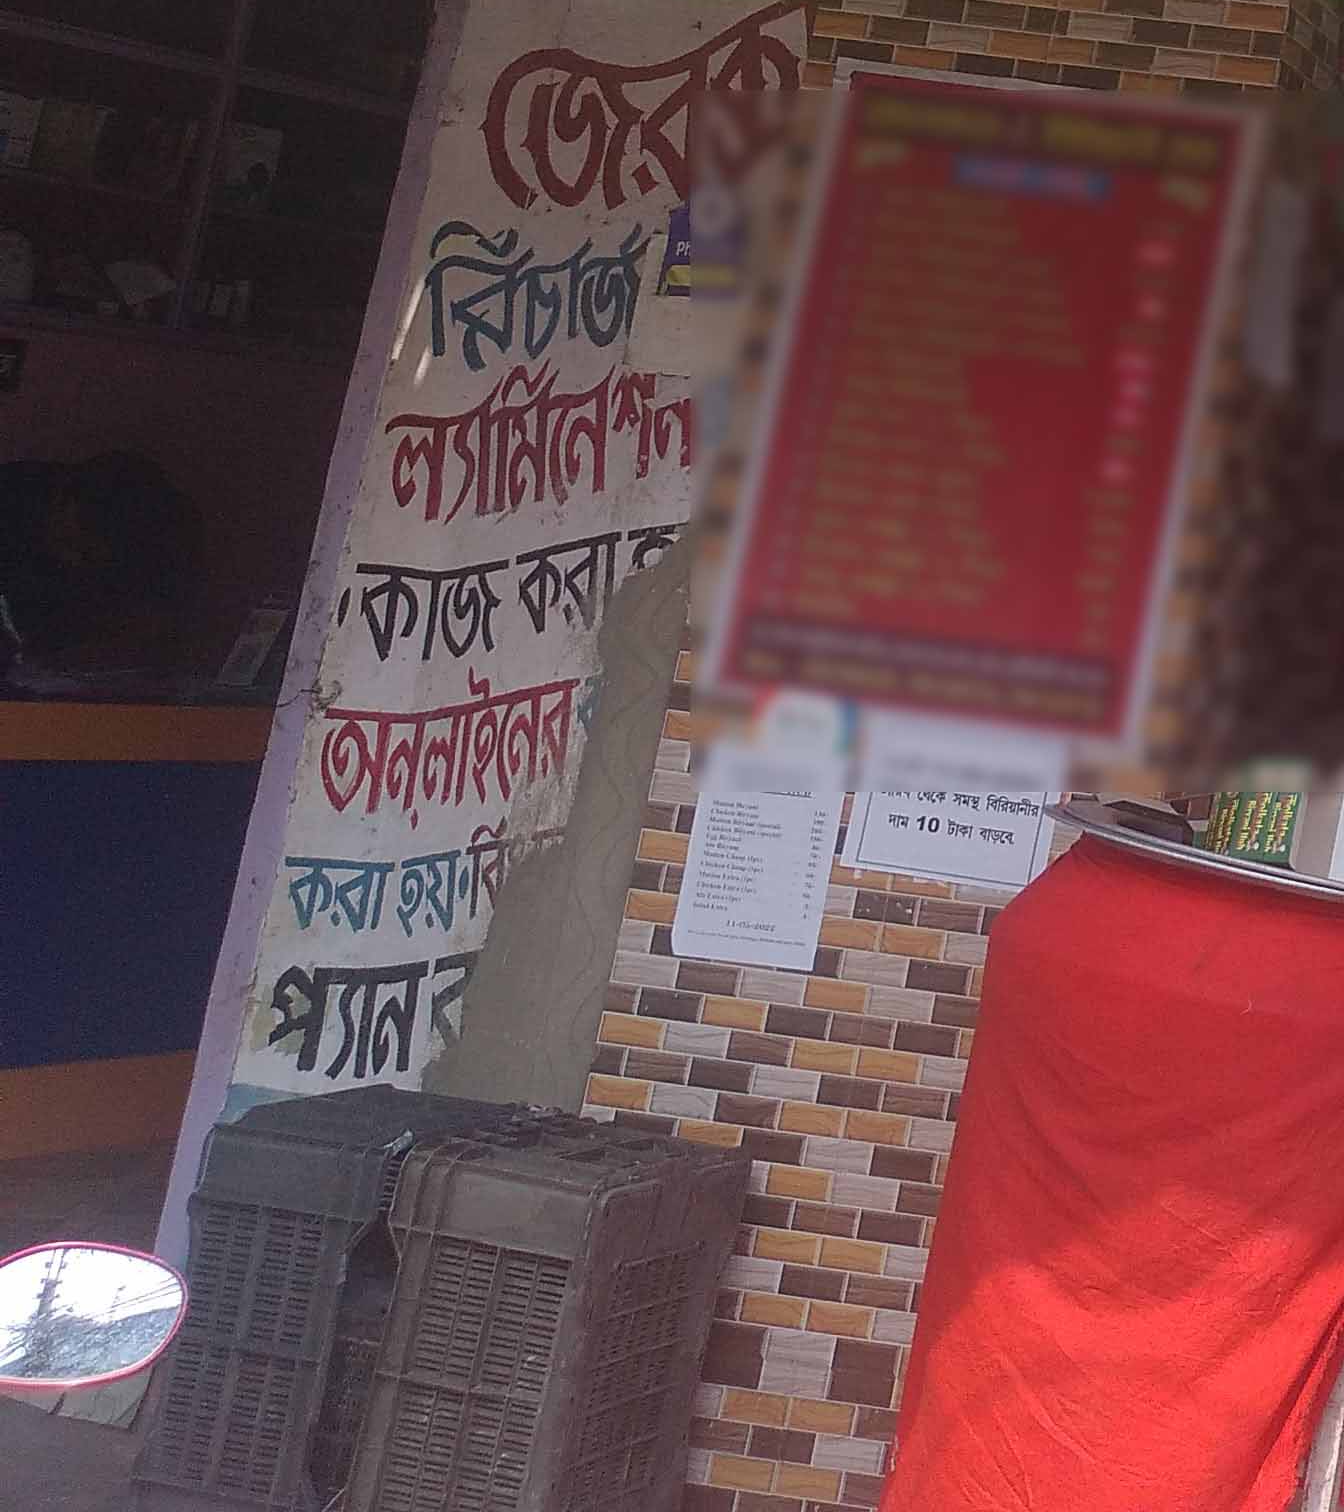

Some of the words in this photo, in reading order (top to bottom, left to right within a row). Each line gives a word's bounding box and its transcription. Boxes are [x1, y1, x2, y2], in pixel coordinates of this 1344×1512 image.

[355, 559, 510, 661] কাজ
[916, 816, 940, 833] 10
[285, 856, 395, 933] করা
